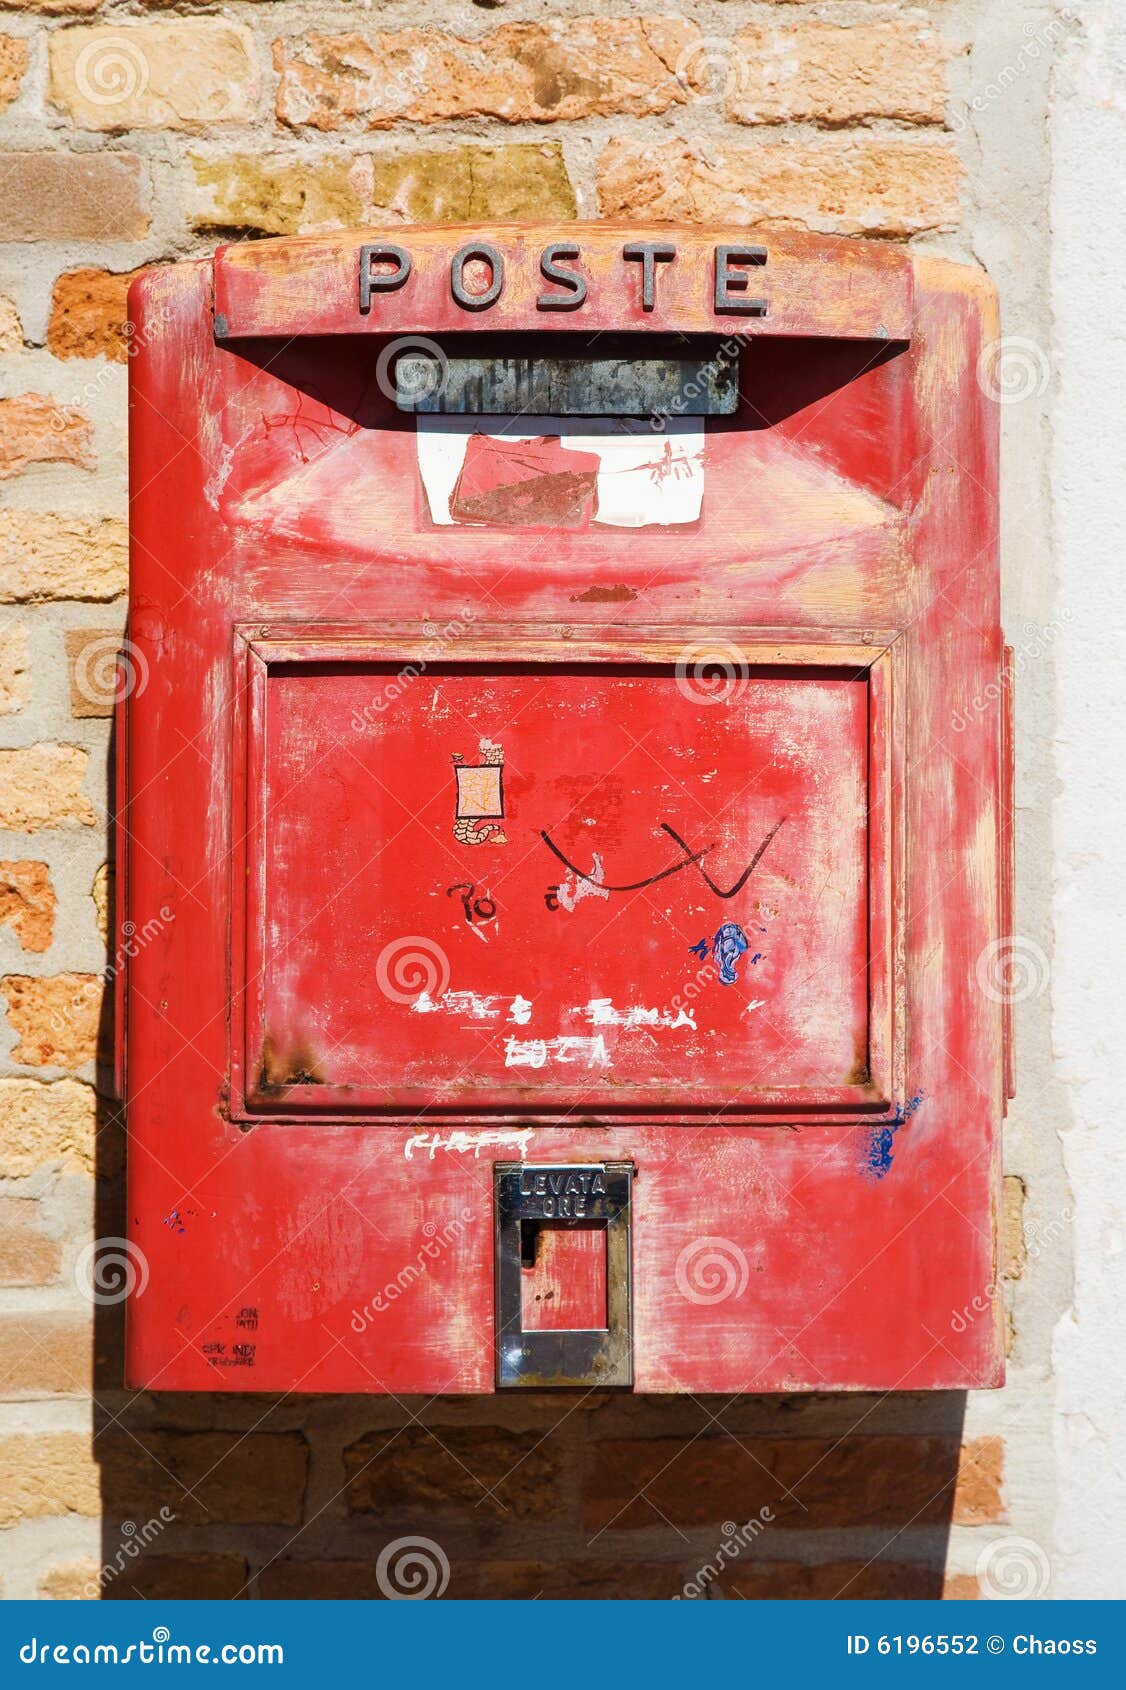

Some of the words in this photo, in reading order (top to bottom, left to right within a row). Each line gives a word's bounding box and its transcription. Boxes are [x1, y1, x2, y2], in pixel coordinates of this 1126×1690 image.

[359, 242, 768, 316] POSTE
[520, 1174, 606, 1195] LEVATA
[543, 1198, 586, 1217] ORE
